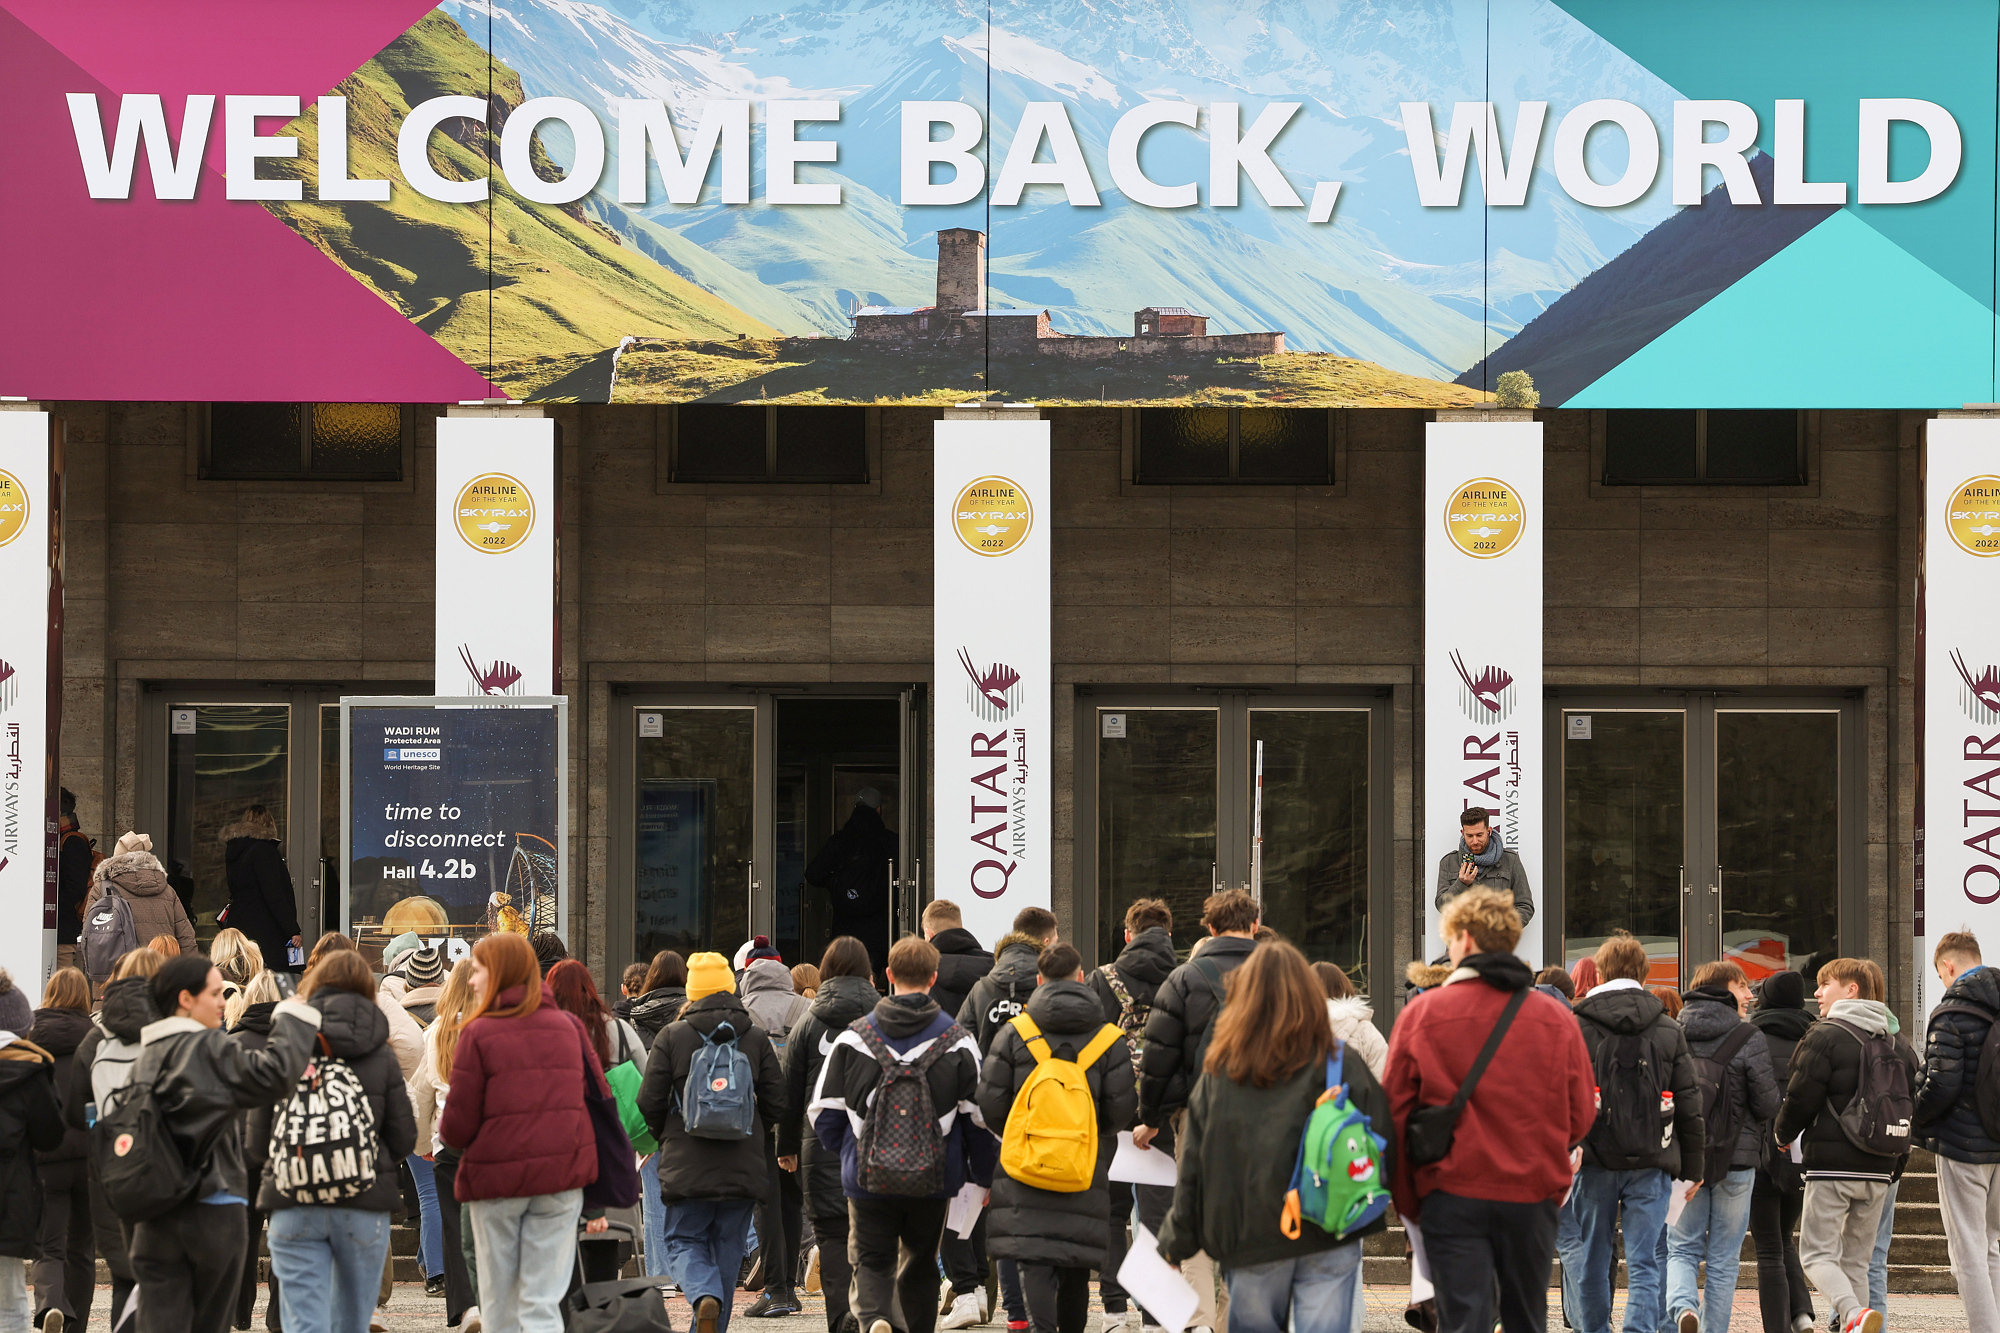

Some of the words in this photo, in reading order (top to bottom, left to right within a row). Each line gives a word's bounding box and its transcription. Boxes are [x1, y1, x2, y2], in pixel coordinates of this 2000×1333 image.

[64, 92, 842, 205] WELCOME
[900, 100, 1343, 223] BACK,
[1399, 97, 1962, 207] WORLD
[471, 486, 517, 495] AIRLINE
[970, 488, 1014, 498] AIRLINE
[1462, 490, 1507, 499] AIRLINE
[460, 508, 528, 517] SKYTRAX
[958, 511, 1027, 520] SKYTRAX
[1450, 513, 1519, 522] SKYTRAX
[483, 536, 506, 545] 2022
[981, 539, 1004, 547] 2022
[1473, 541, 1497, 549] 2022
[1975, 539, 1999, 548] 2022
[384, 726, 413, 736] WADI
[415, 726, 440, 736] RUM
[384, 737, 422, 745] Protected
[423, 737, 441, 745] Area
[403, 750, 438, 758] unesco
[1012, 728, 1029, 785] القطرية
[1505, 731, 1522, 787] القطرية
[384, 803, 433, 820] time
[439, 803, 462, 820] to
[970, 729, 1017, 900] QATAR
[4, 782, 20, 856] AIRWAYS
[1012, 786, 1026, 860] AIRWAYS
[1505, 790, 1519, 853] IRWAYS
[1963, 733, 2000, 905] QATAR
[384, 830, 506, 848] disconnect
[383, 865, 416, 879] Hall
[419, 858, 477, 879] 4.2b
[1885, 1123, 1909, 1138] PUM
